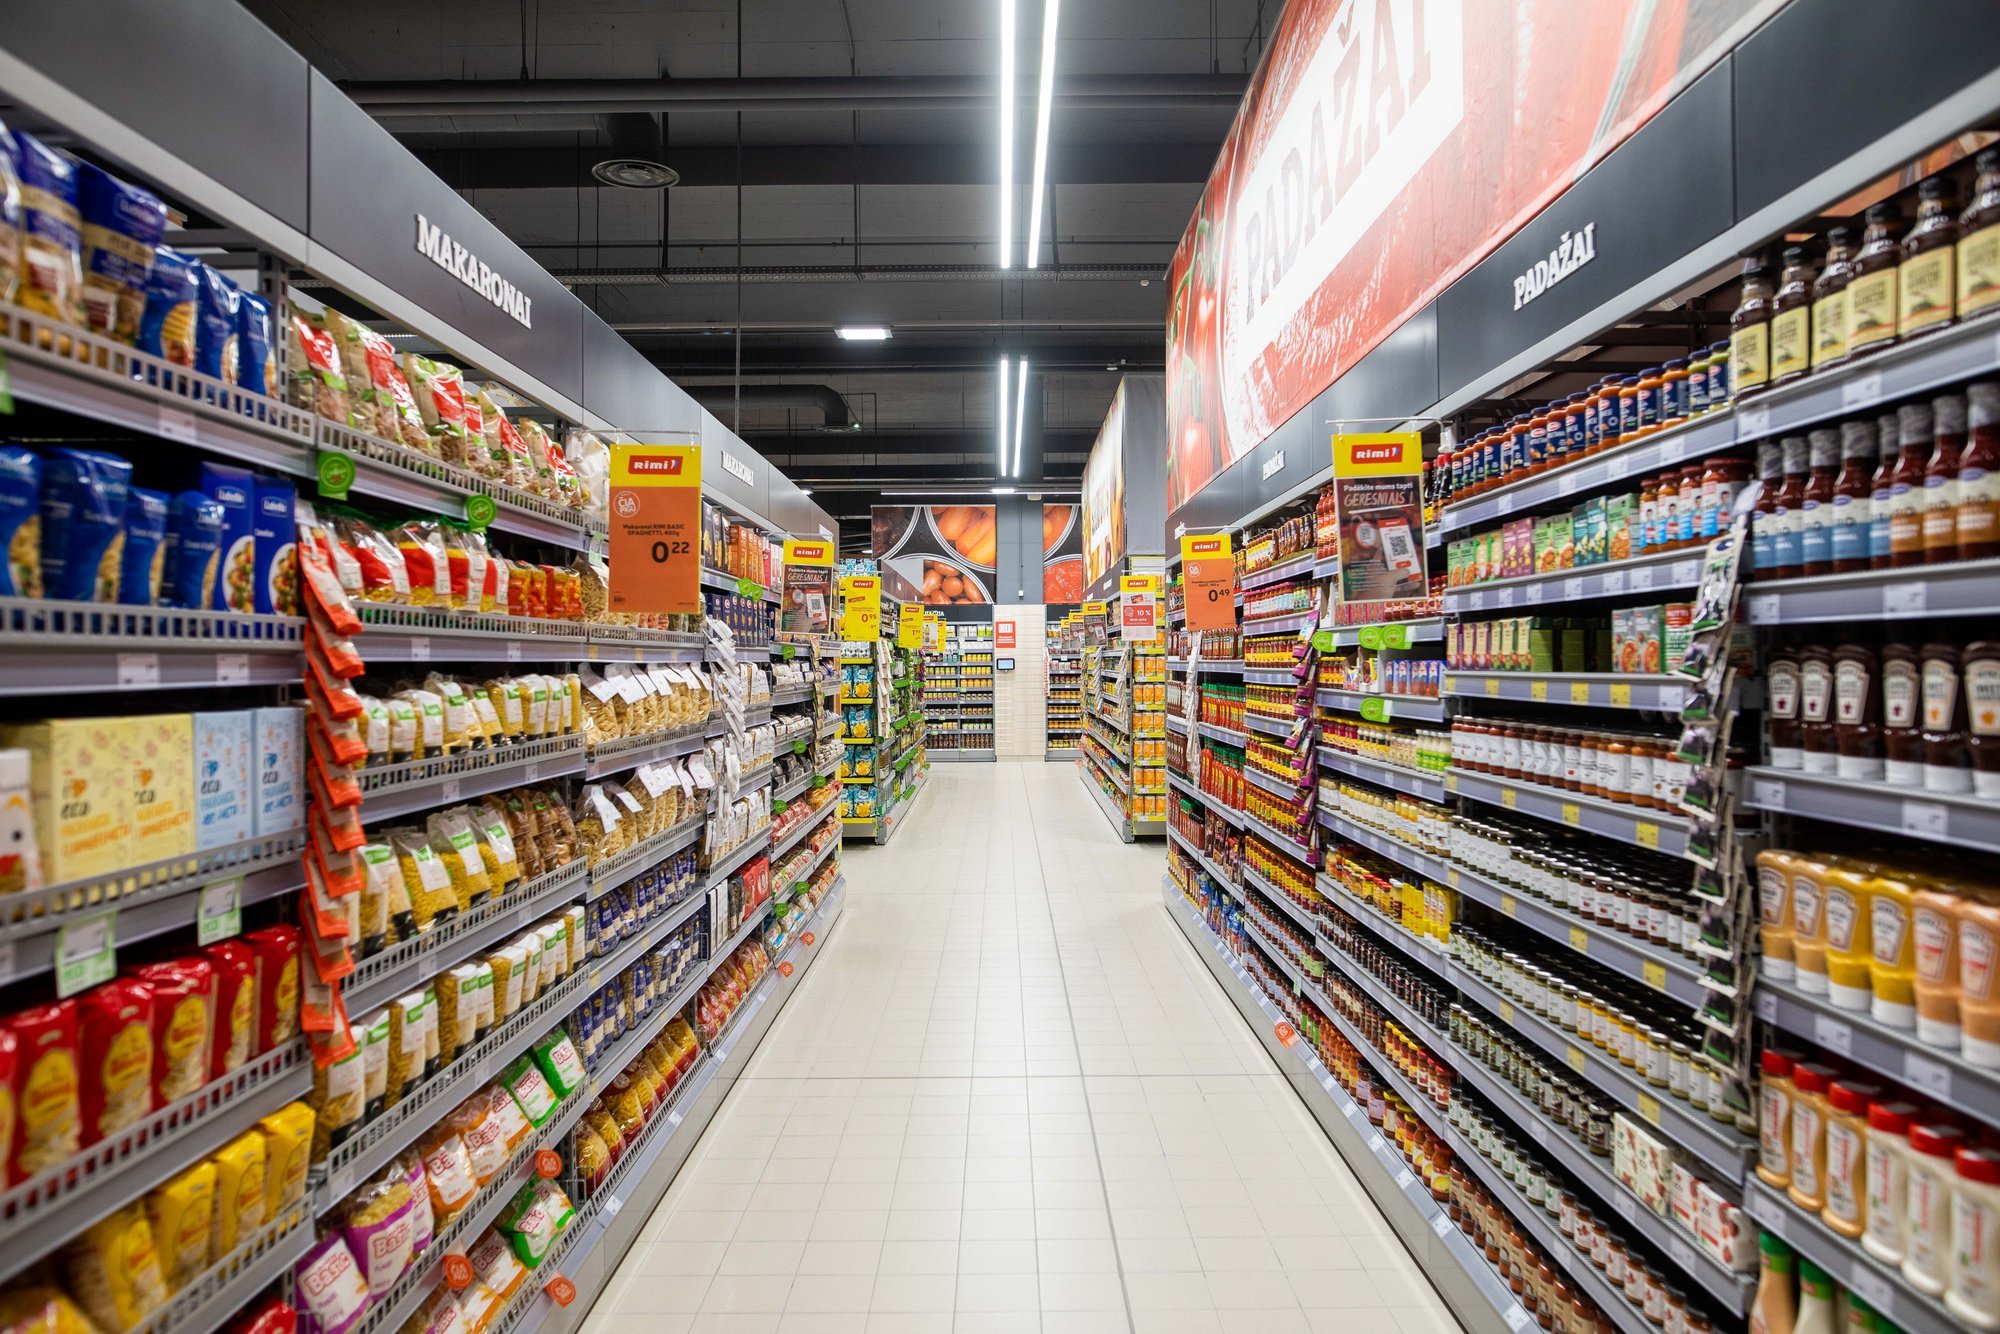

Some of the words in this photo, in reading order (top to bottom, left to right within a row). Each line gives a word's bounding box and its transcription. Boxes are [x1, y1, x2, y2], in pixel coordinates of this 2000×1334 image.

[416, 213, 532, 329] MAKARONAI
[1513, 222, 1597, 311] PADAŽAI
[1356, 449, 1389, 458] Rimi
[633, 459, 668, 470] Rimi
[1396, 482, 1413, 490] tapti
[618, 495, 635, 506] ČIA
[1344, 491, 1405, 507] GERESNIAIS
[651, 541, 669, 563] 0
[671, 542, 690, 554] 22
[787, 572, 823, 582] GERESNIAIS
[304, 1252, 351, 1297] Basic
